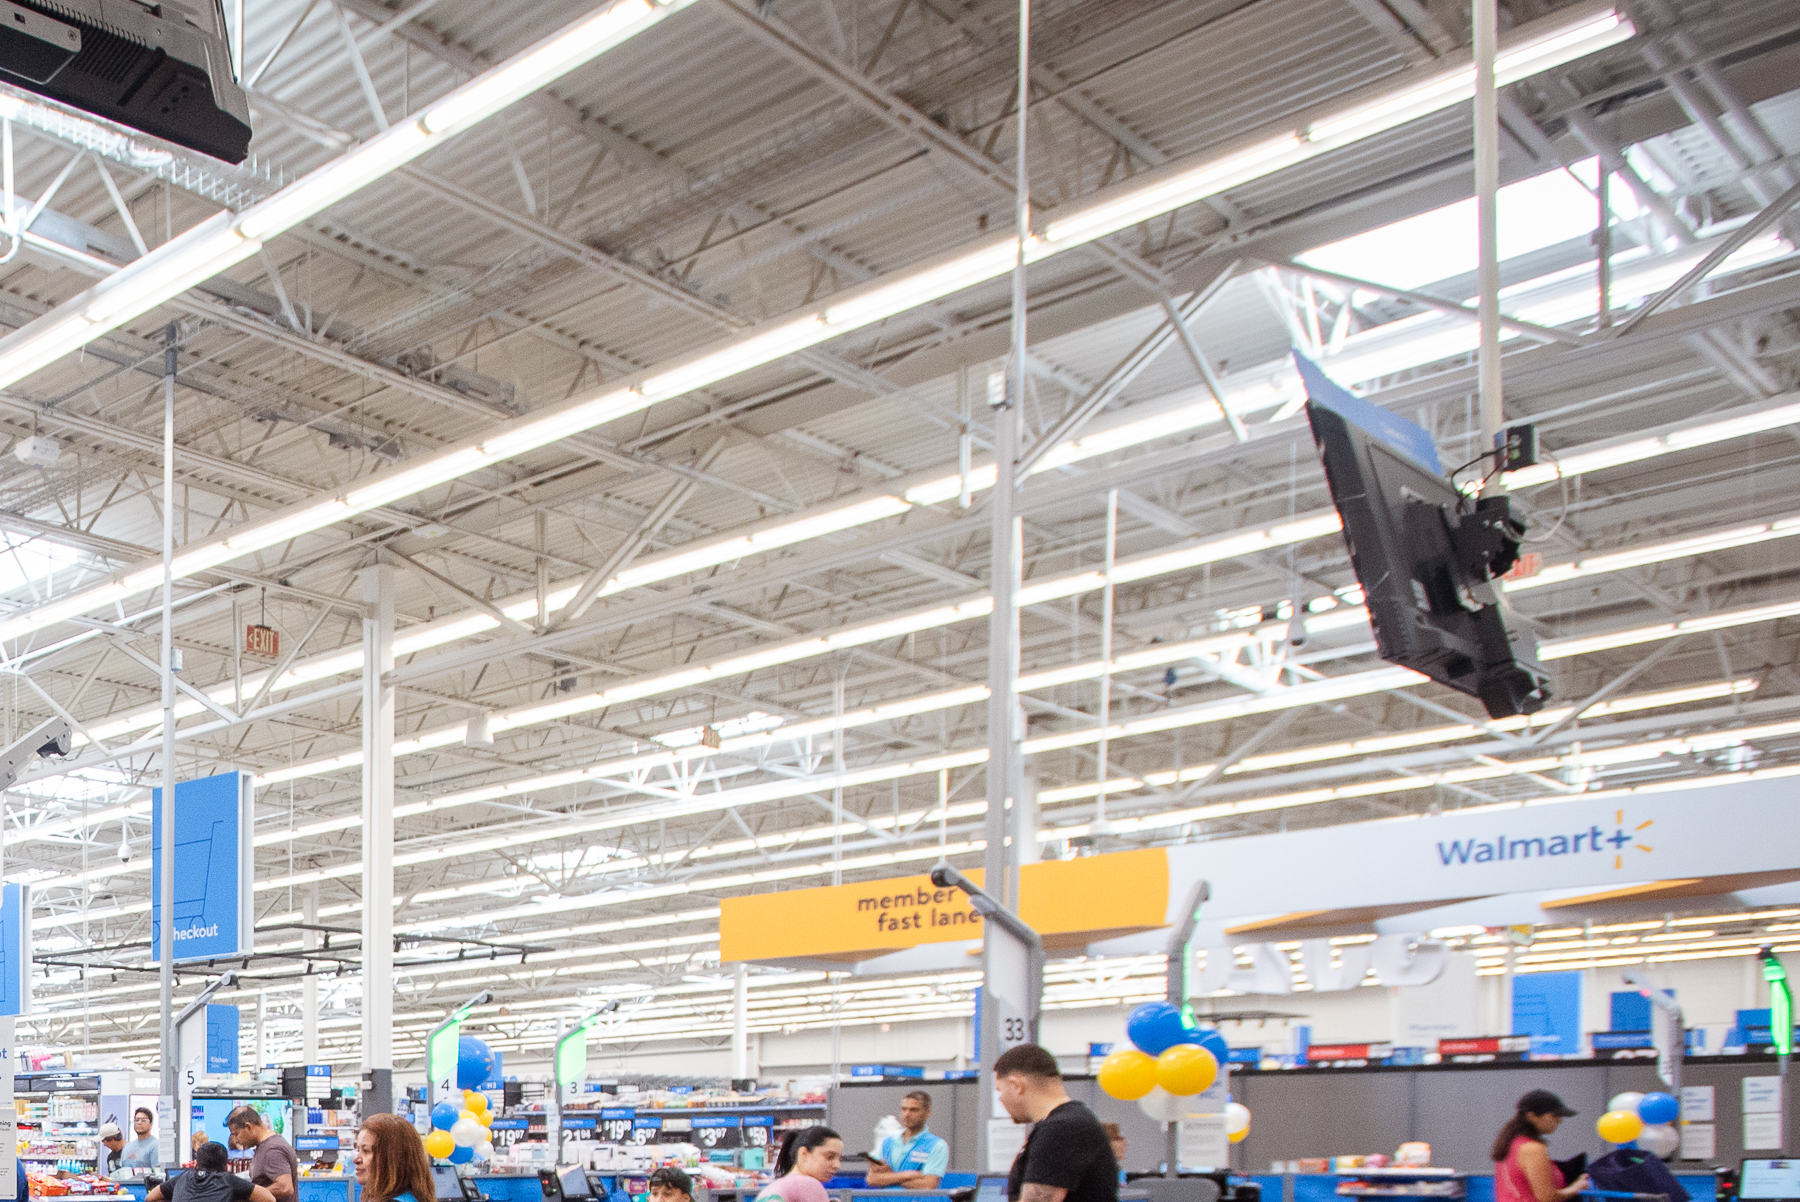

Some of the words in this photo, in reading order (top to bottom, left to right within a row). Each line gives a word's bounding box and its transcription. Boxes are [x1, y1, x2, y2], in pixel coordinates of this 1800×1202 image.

[254, 629, 274, 653] EXIT
[877, 912, 922, 932] fast
[930, 907, 981, 928] lane
[173, 923, 219, 941] heckout
[1004, 1017, 1025, 1042] 33
[187, 1071, 195, 1085] 5
[314, 1067, 324, 1075] F5
[441, 1078, 450, 1091] 4
[570, 1082, 578, 1094] 3
